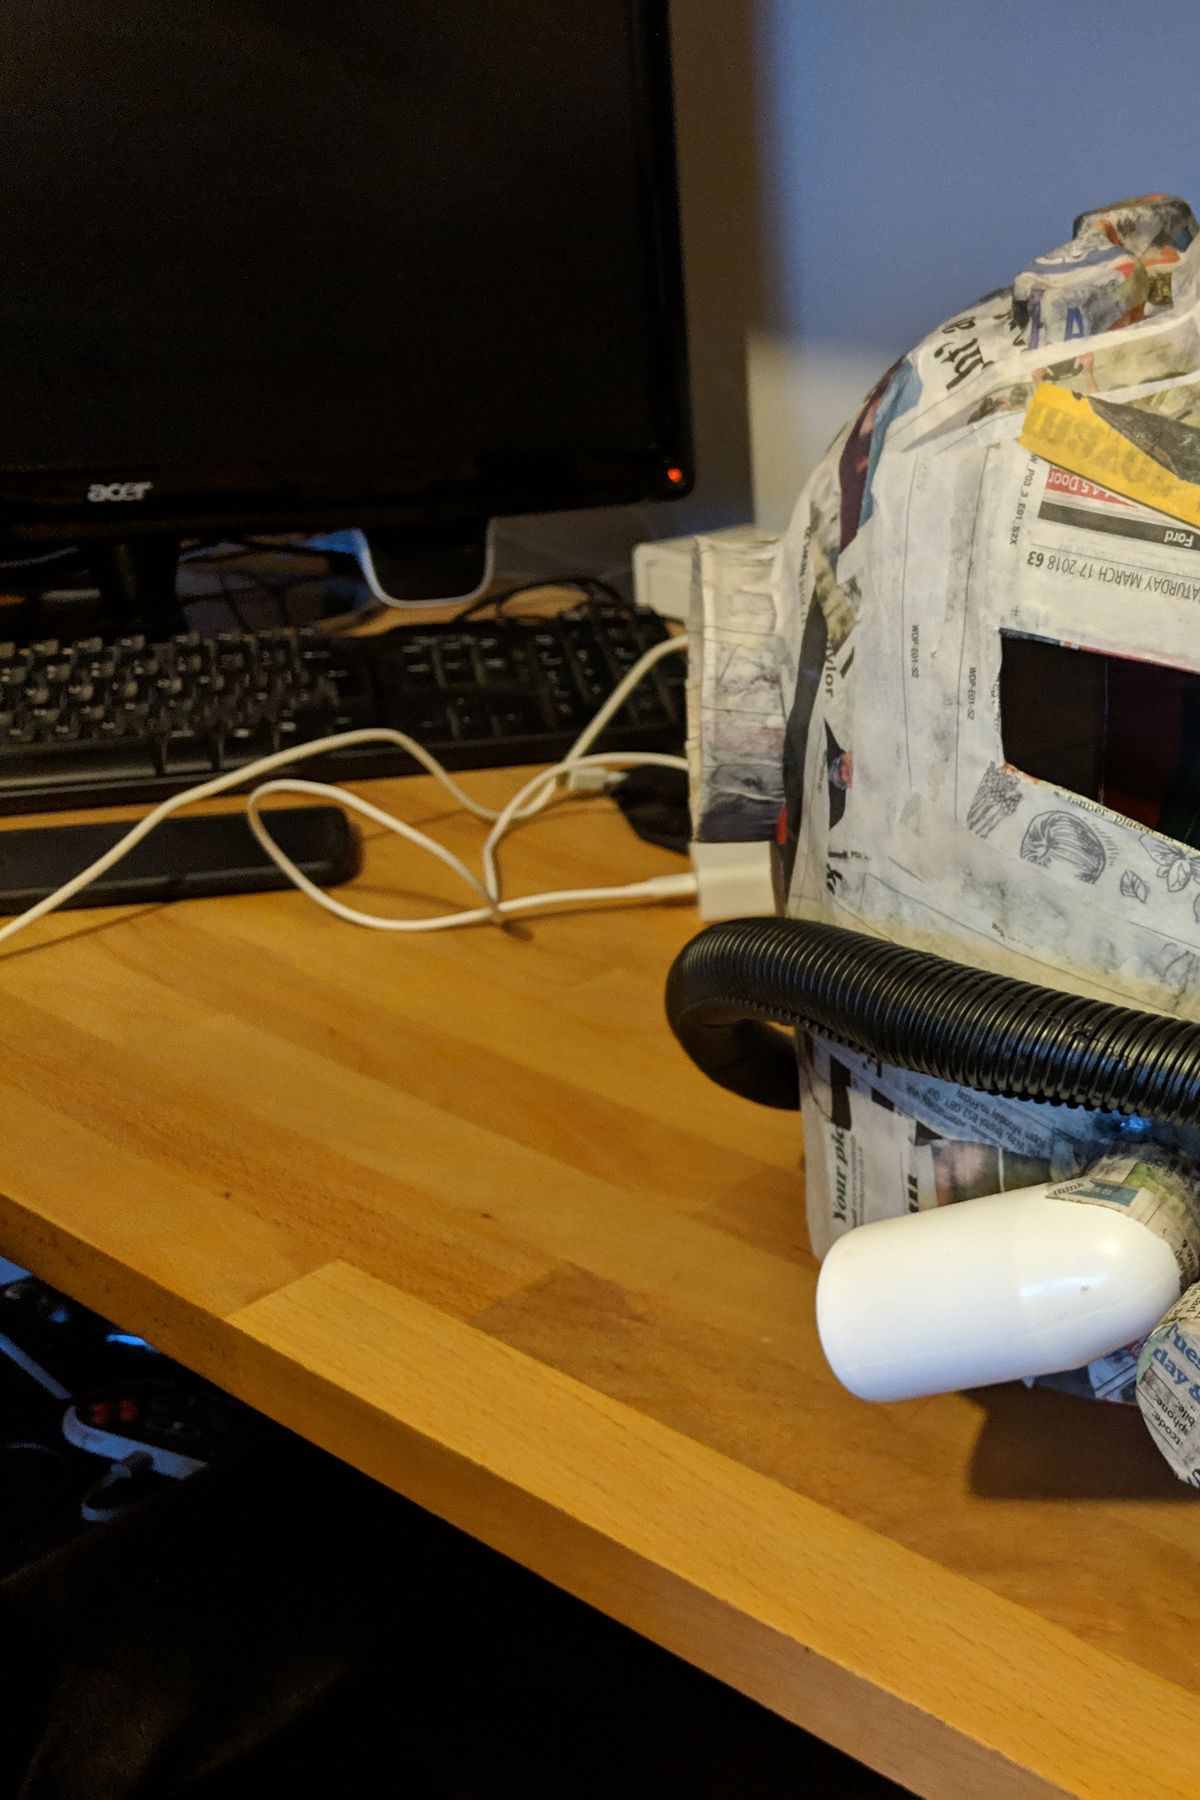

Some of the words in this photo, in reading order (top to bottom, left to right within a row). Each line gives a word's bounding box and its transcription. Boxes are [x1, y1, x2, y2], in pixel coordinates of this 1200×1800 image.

[87, 481, 154, 502] acer
[1163, 528, 1194, 547] Ford
[1025, 549, 1045, 567] 63
[1045, 553, 1077, 575] 2018
[1077, 561, 1094, 577] 17
[1097, 565, 1143, 590] MARCH
[1148, 1346, 1192, 1387] day
